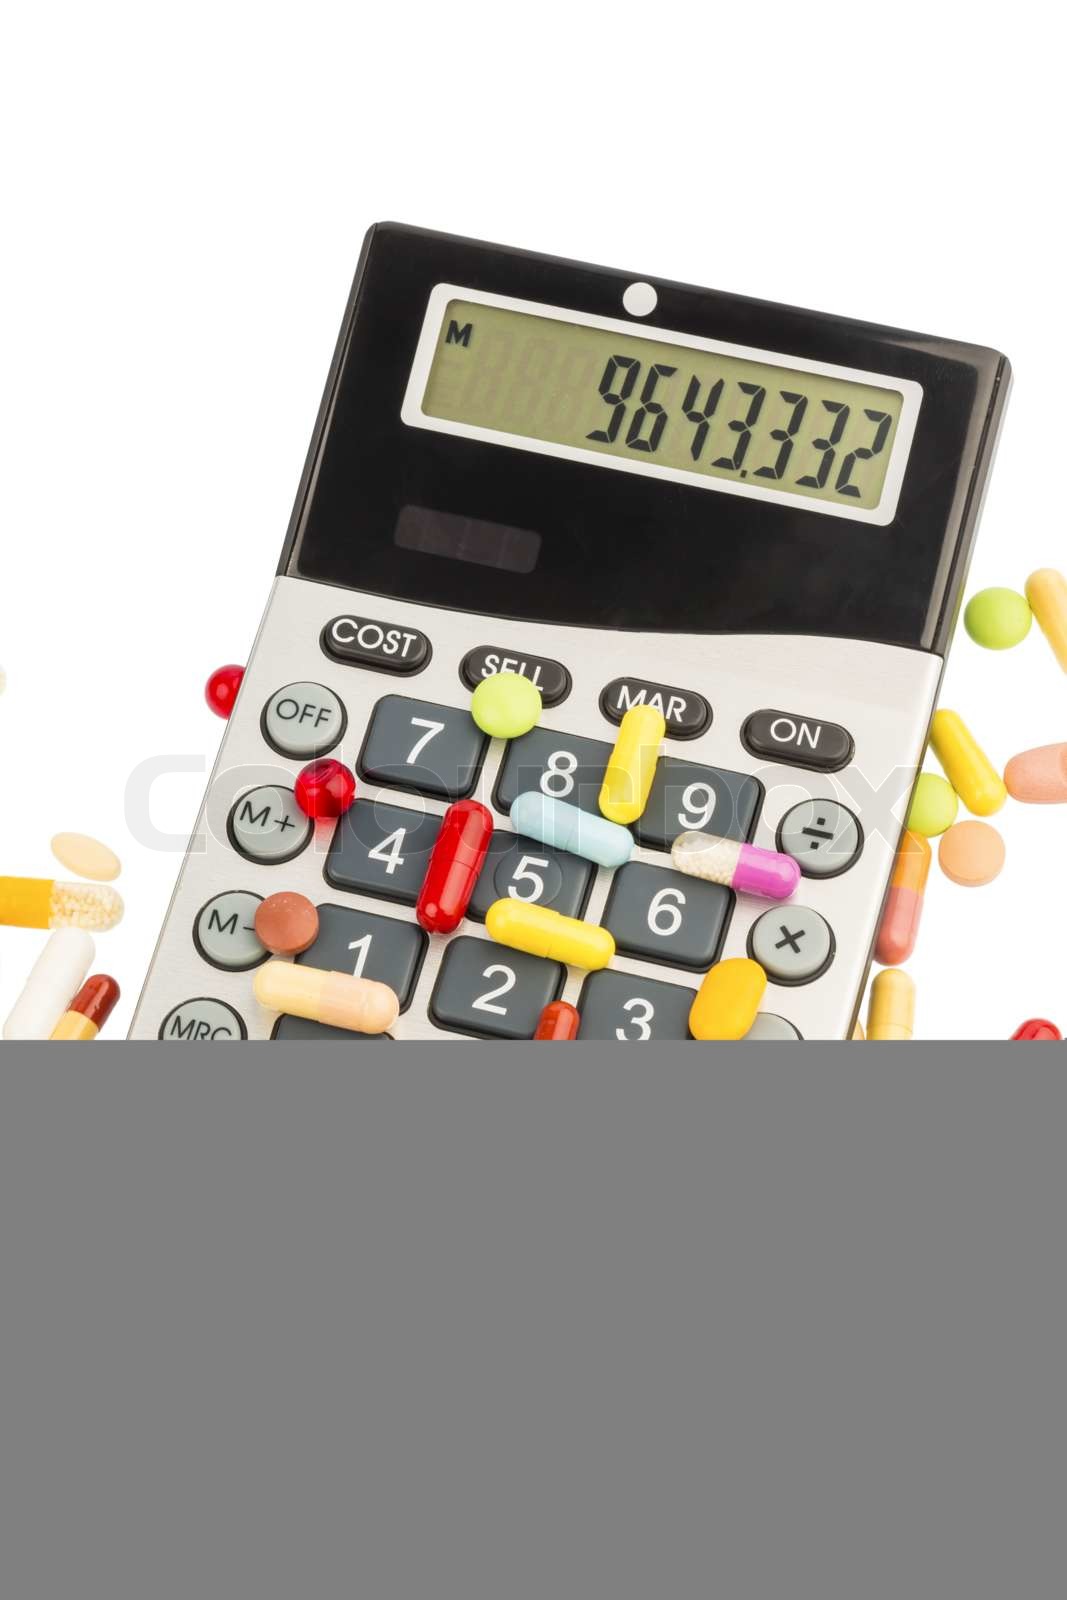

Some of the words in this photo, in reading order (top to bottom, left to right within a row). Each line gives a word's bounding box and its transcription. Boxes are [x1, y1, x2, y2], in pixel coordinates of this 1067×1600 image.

[445, 320, 472, 348] M
[586, 355, 892, 498] 9643.332
[331, 617, 417, 658] COST
[275, 698, 332, 728] OFF
[616, 685, 687, 723] MAR
[405, 717, 446, 764] 7
[770, 717, 822, 750] ON
[539, 750, 579, 798] 8
[238, 800, 296, 834] M+
[677, 782, 717, 830] 9
[367, 827, 407, 875] 4
[507, 855, 549, 904] 5
[646, 887, 686, 937] 6
[347, 934, 373, 979] 1
[471, 964, 517, 1015] 2
[615, 997, 655, 1041] 3
